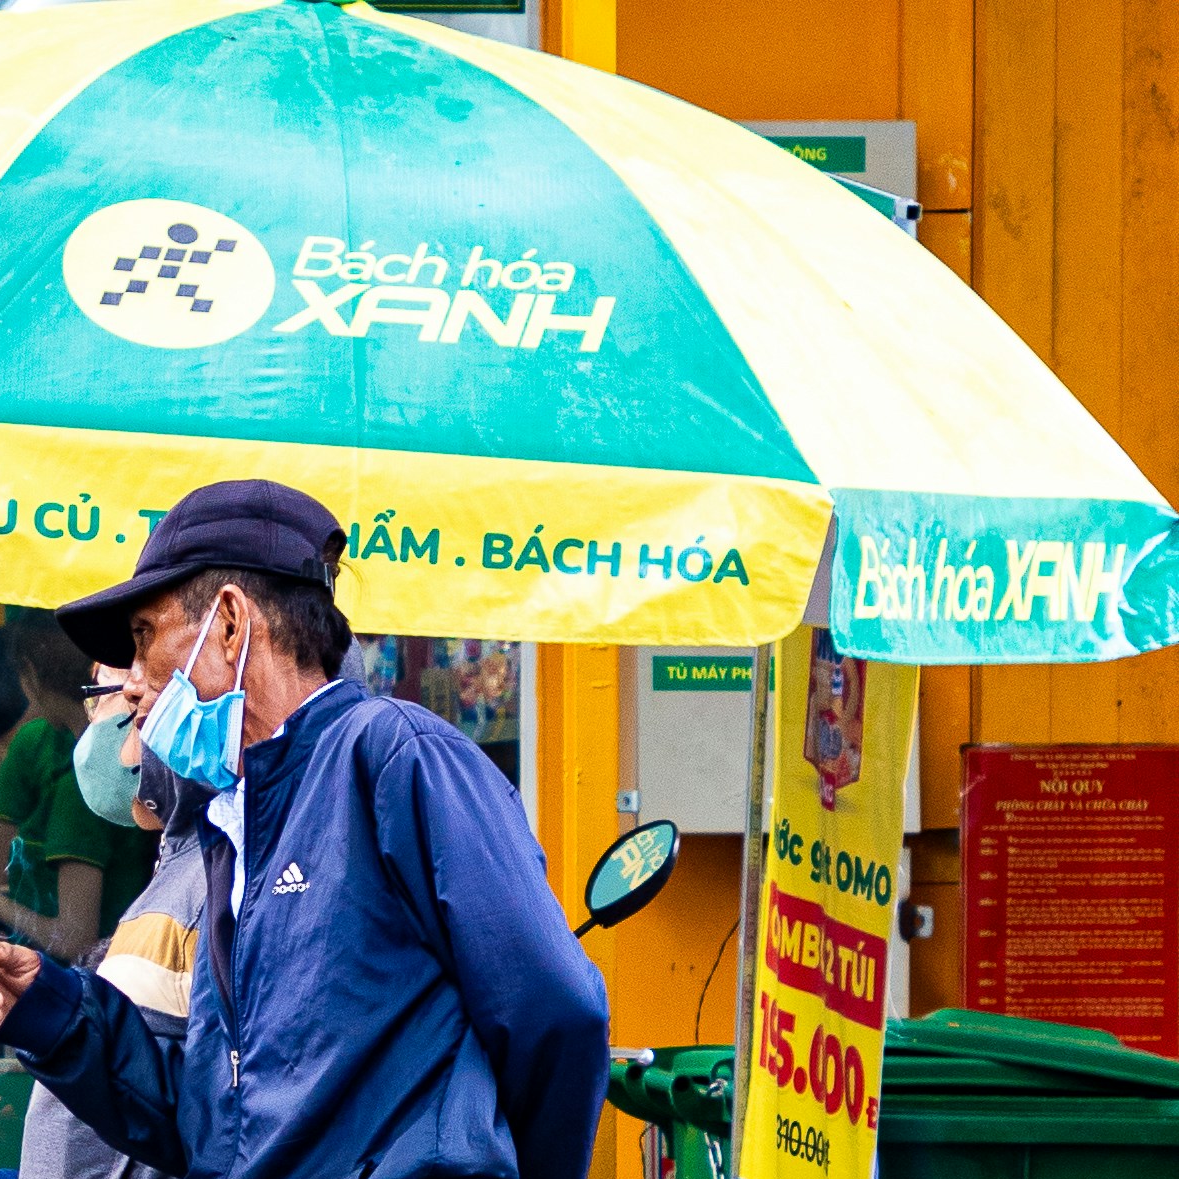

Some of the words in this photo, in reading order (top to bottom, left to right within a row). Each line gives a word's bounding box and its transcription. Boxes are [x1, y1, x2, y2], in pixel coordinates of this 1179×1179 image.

[292, 235, 449, 286] Bách
[460, 246, 576, 292] hóa
[272, 279, 616, 352] XANH
[34, 493, 100, 541] CỦ
[482, 524, 622, 578] BÁCH
[638, 534, 750, 586] HÓA
[854, 535, 926, 620] Bách
[931, 537, 995, 622] hóa
[994, 538, 1127, 622] XANH
[691, 662, 728, 680] MÁY
[1039, 775, 1069, 796] NỘI
[1072, 779, 1106, 796] QUY
[836, 851, 892, 906] OMO
[838, 941, 876, 1002] TÚI
